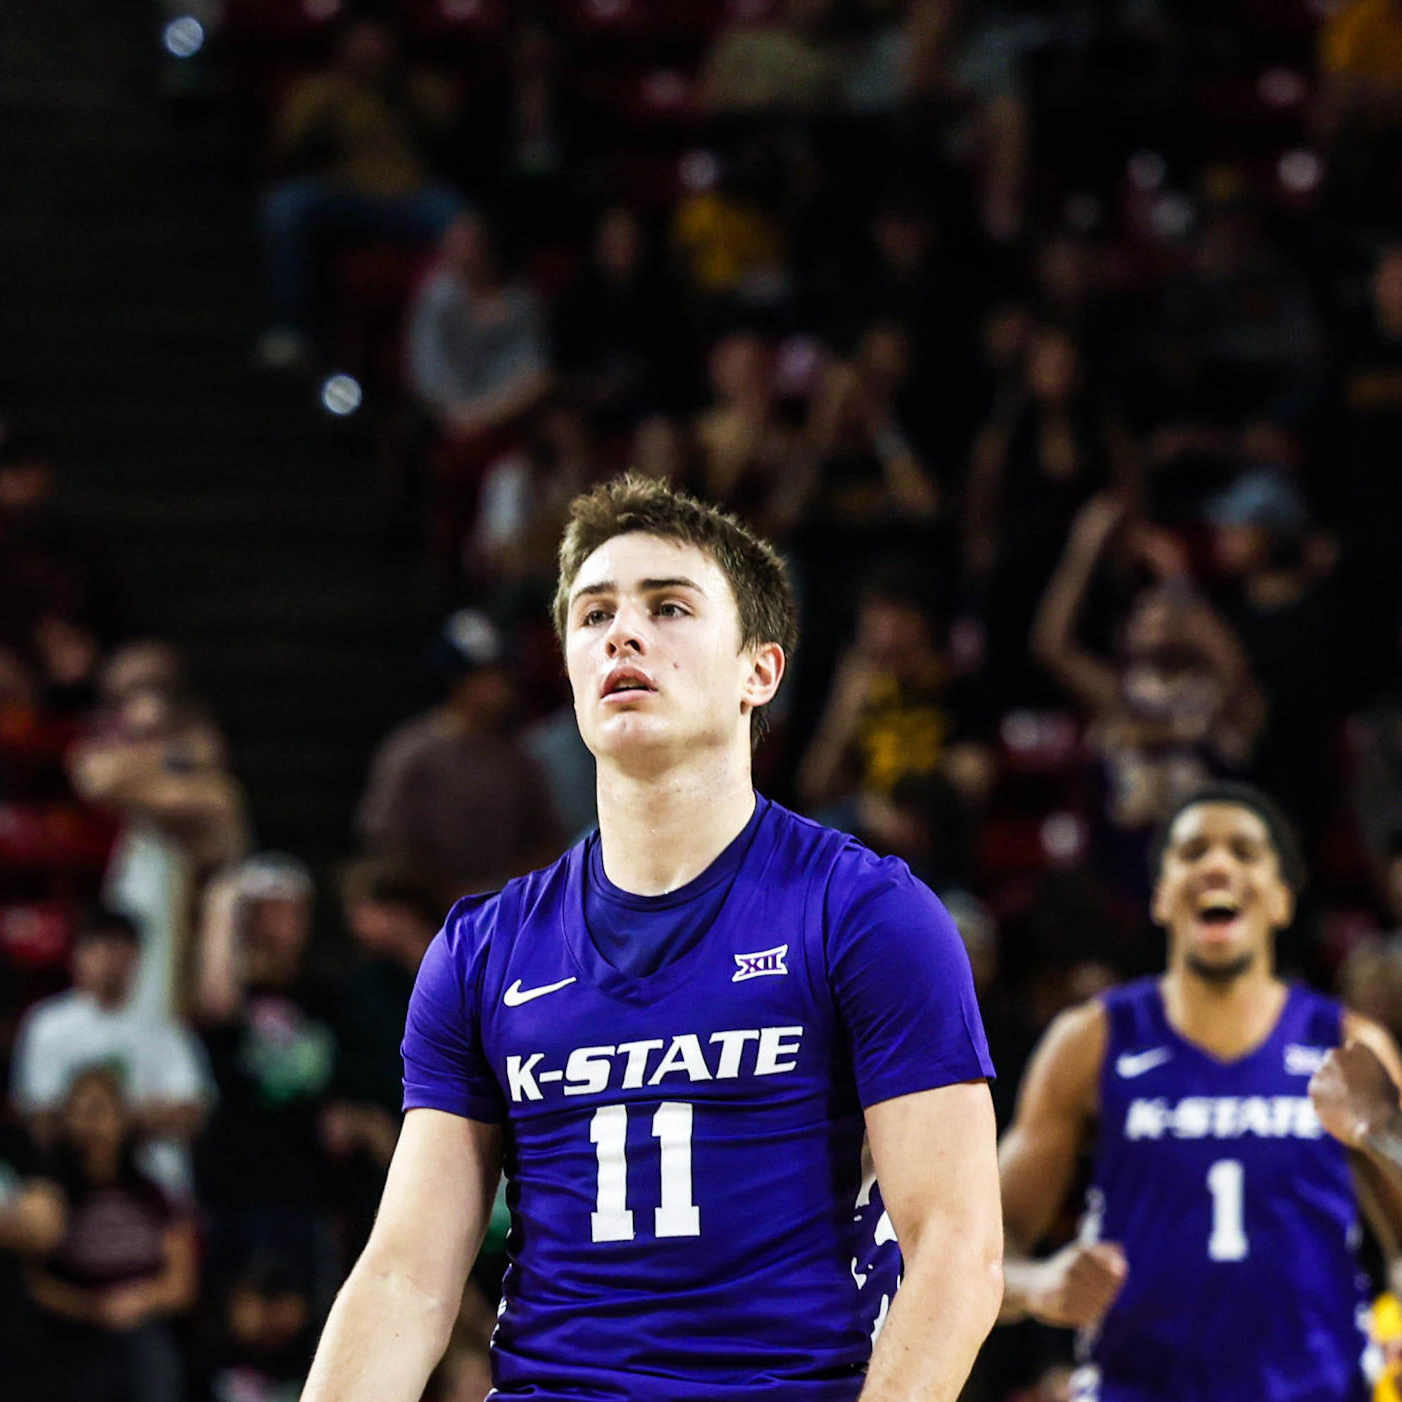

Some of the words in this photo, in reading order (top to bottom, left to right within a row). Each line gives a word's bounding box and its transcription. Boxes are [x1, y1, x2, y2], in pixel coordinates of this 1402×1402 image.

[735, 948, 786, 980] XII
[506, 1025, 803, 1102] K-STATE
[1125, 1096, 1325, 1141] K-STATE
[589, 1101, 700, 1243] 11
[1207, 1160, 1249, 1261] 1
